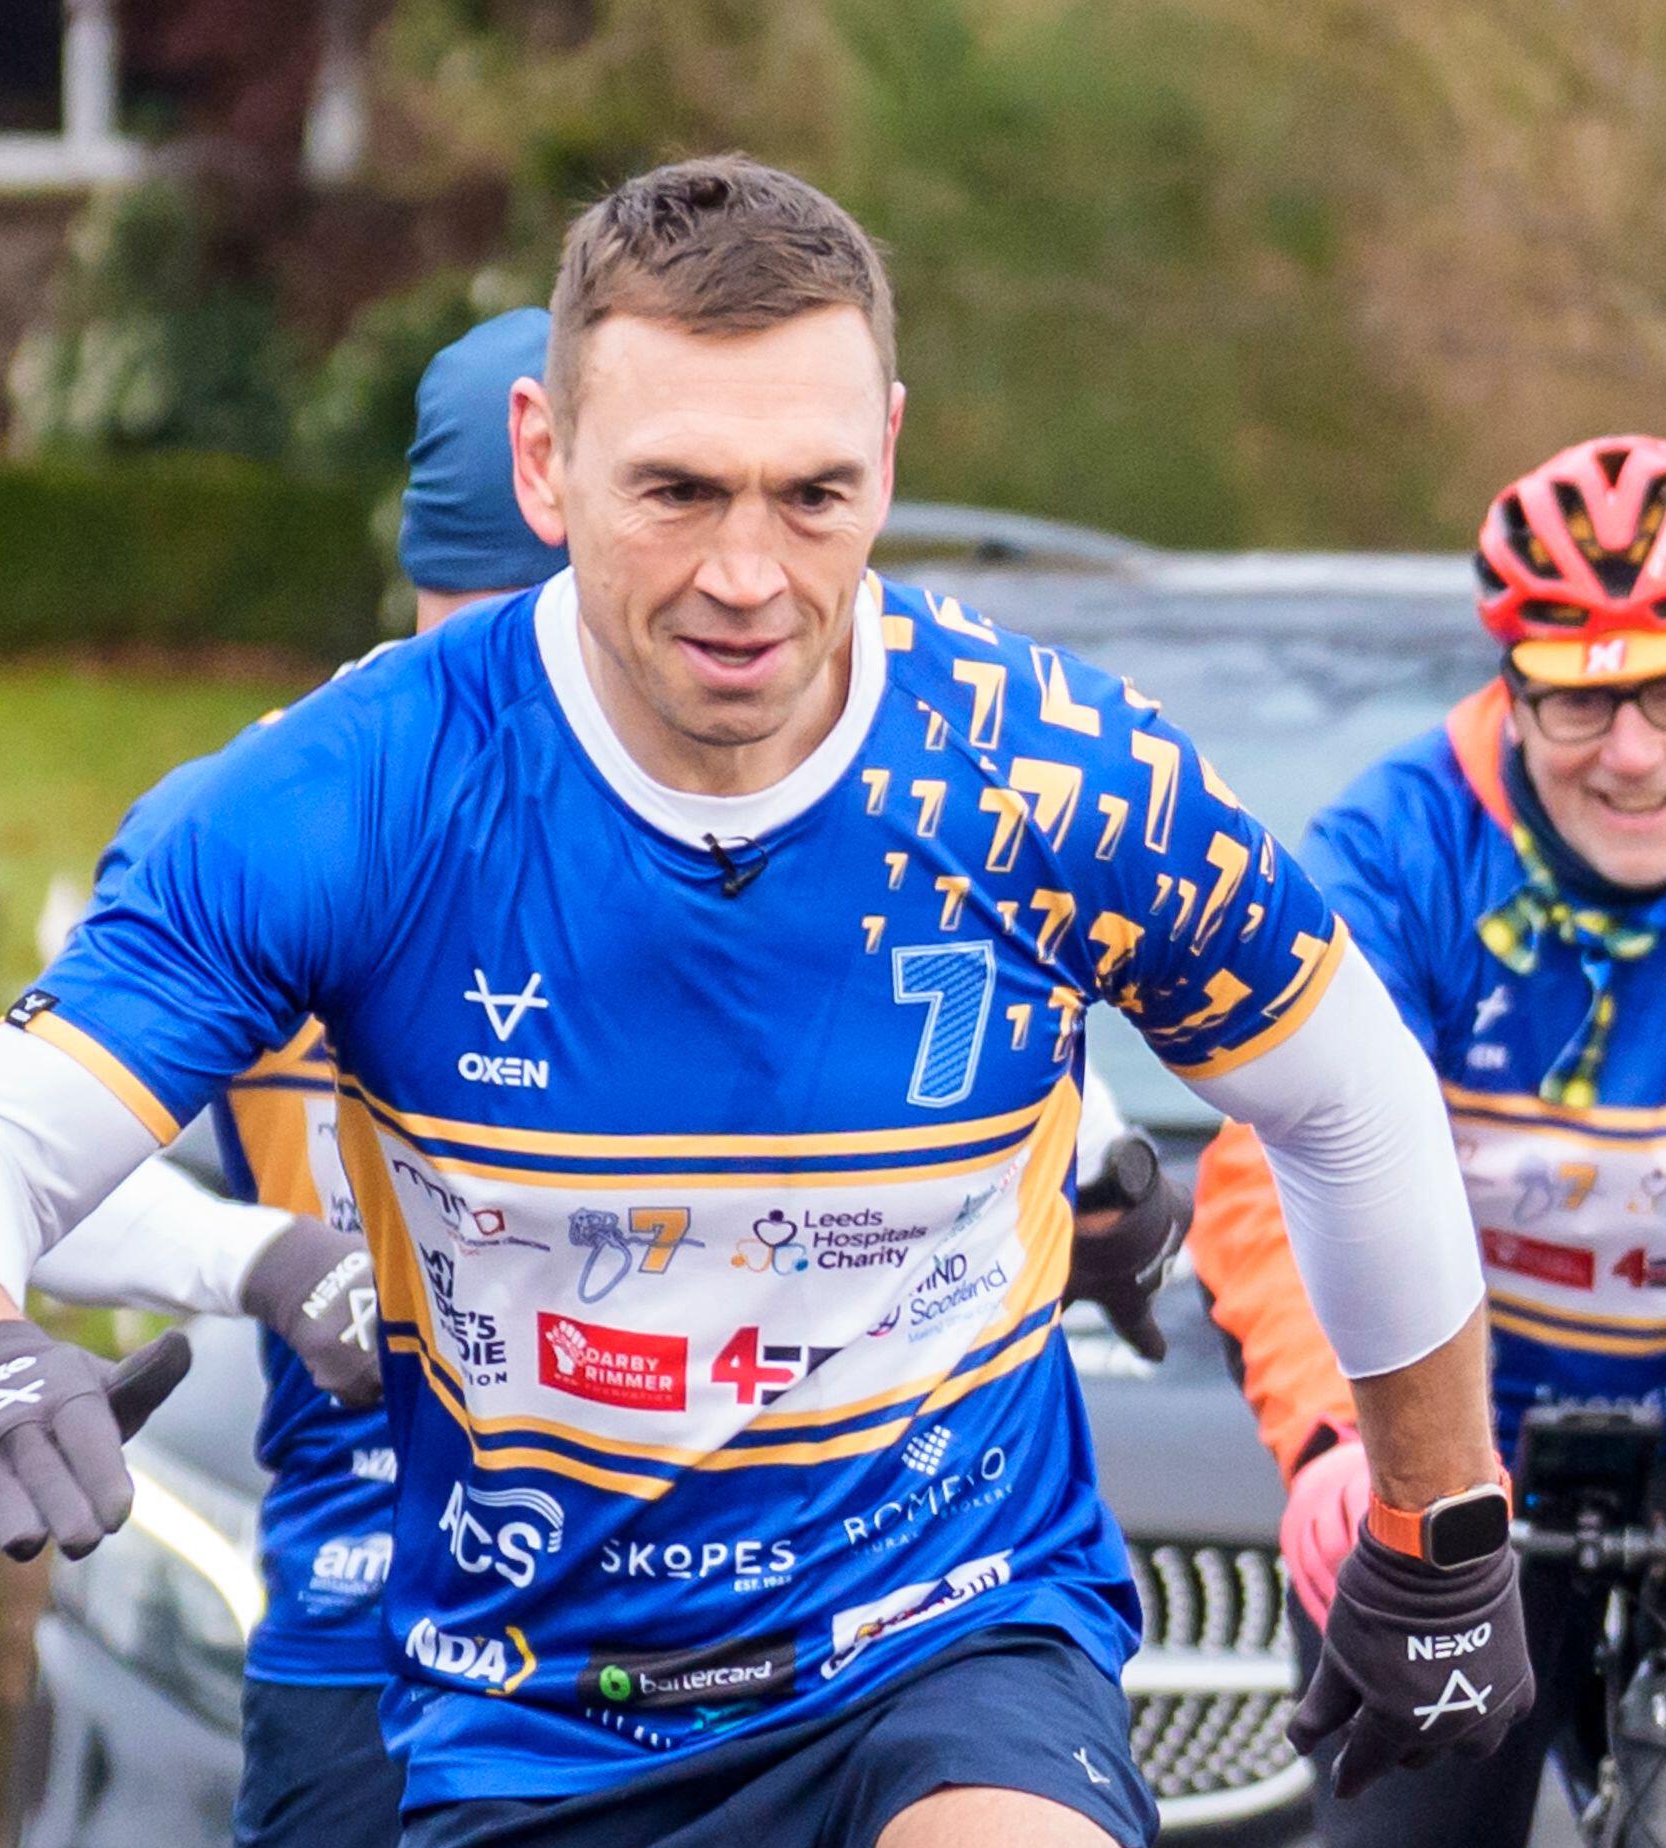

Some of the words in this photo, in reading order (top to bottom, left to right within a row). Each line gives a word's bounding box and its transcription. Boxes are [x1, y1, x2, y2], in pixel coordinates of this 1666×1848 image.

[891, 940, 997, 1109] 7
[458, 1052, 550, 1088] OXEN
[803, 1208, 883, 1229] Leeds
[812, 1225, 929, 1250] Hospitals
[817, 1246, 910, 1270] Charity
[584, 1348, 660, 1372] DARBY
[584, 1365, 674, 1392] RIMMER
[439, 1480, 543, 1588] ACS
[600, 1539, 796, 1579] SKOPES
